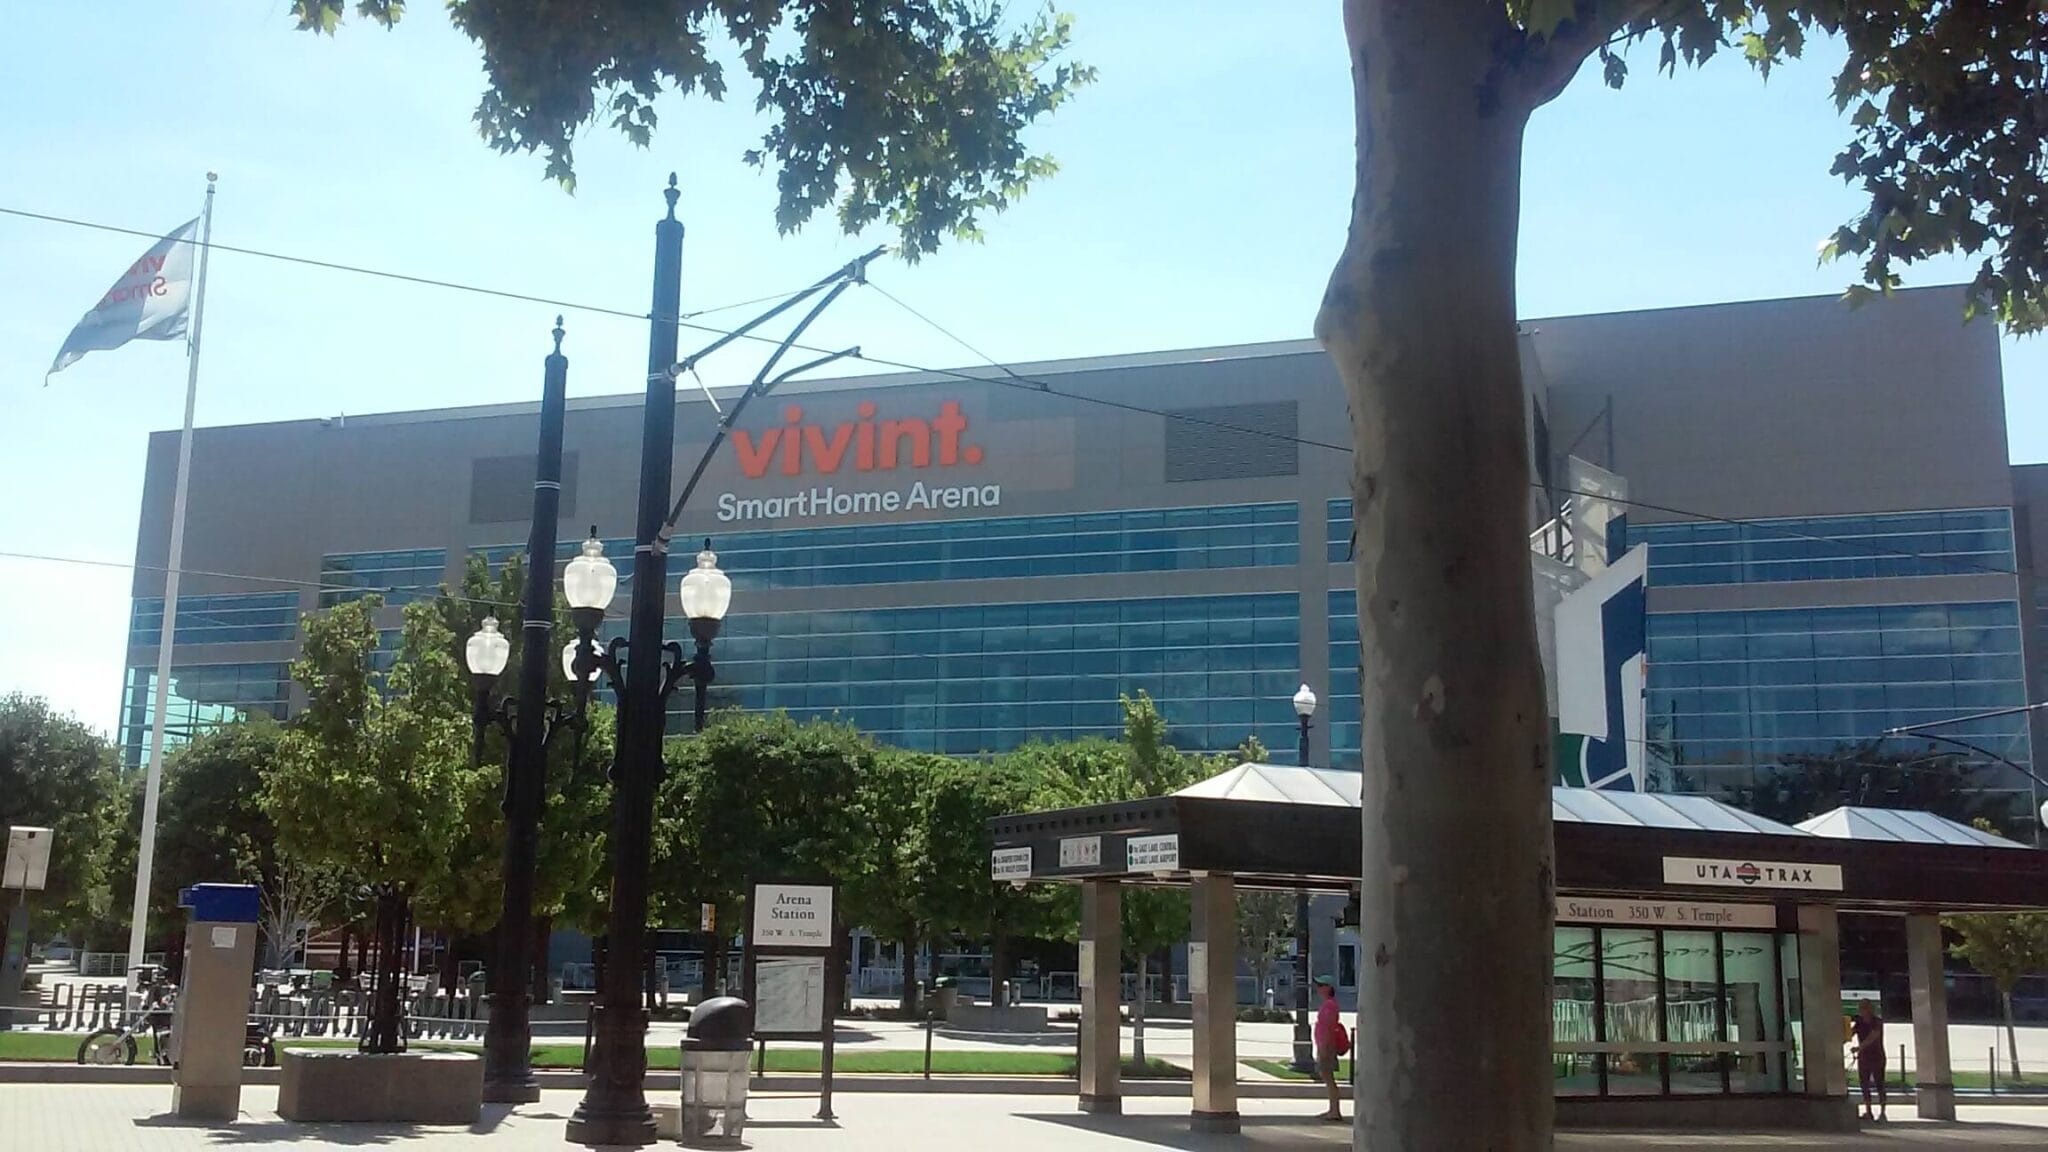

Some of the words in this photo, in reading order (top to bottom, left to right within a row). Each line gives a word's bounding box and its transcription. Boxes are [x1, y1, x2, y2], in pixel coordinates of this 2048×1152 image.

[731, 400, 984, 479] vivint.
[716, 486, 901, 522] SmartHome
[905, 480, 1000, 511] Arena
[1696, 864, 1732, 880] UTA
[1765, 868, 1812, 882] TRAX
[776, 893, 812, 905] Arena
[771, 907, 815, 920] Station
[1568, 902, 1614, 918] Station
[1628, 906, 1649, 919] 350
[1691, 908, 1733, 925] Temple
